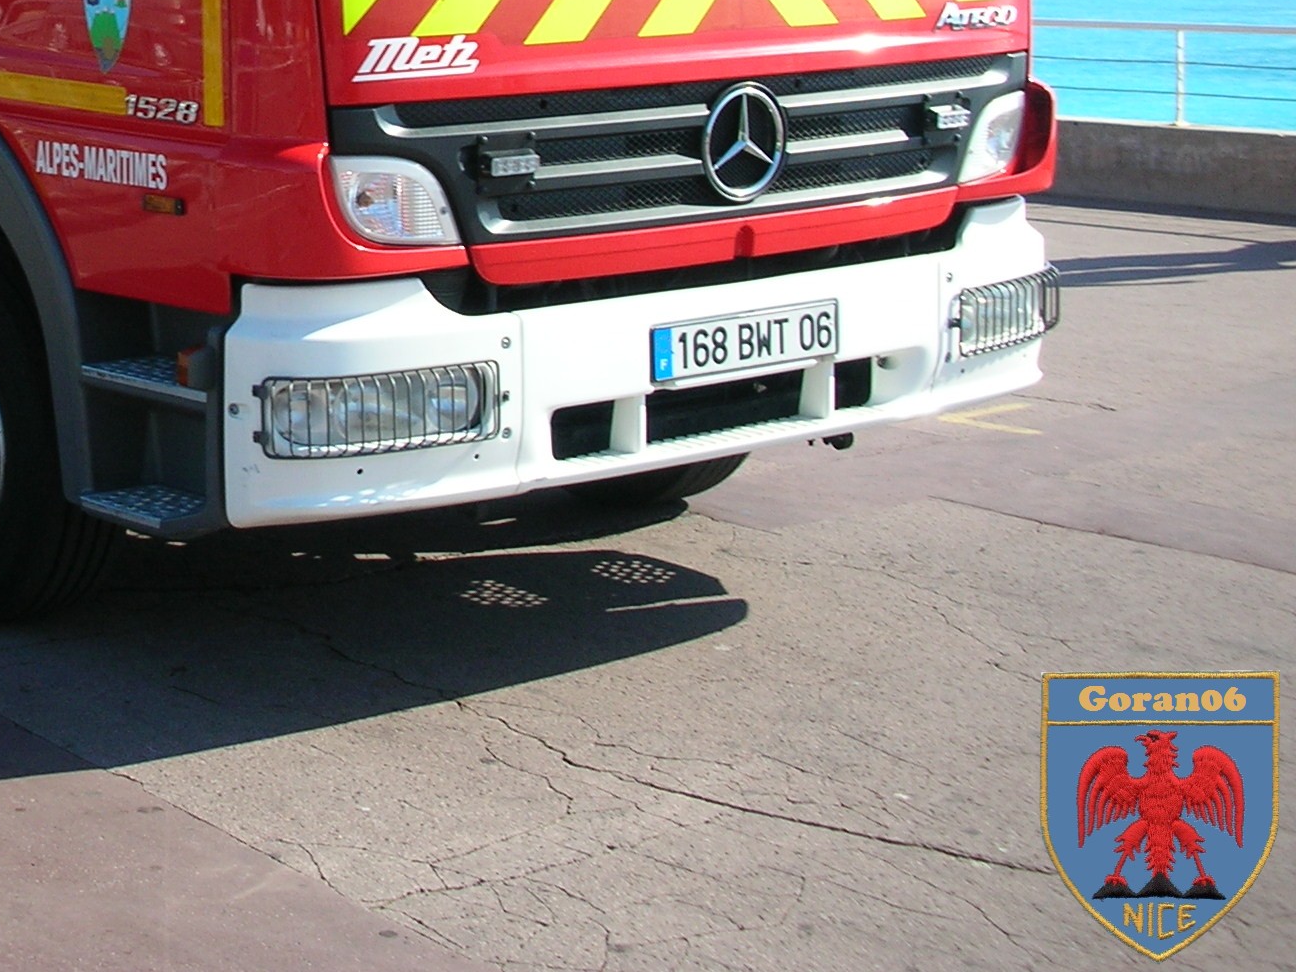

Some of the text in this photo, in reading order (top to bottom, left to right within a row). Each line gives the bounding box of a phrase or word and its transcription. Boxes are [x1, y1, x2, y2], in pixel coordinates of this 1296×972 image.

[351, 34, 480, 83] Metz
[124, 94, 199, 124] 1528
[36, 139, 168, 191] ALPES-MARITIMES
[678, 311, 832, 369] 168 BWT 06
